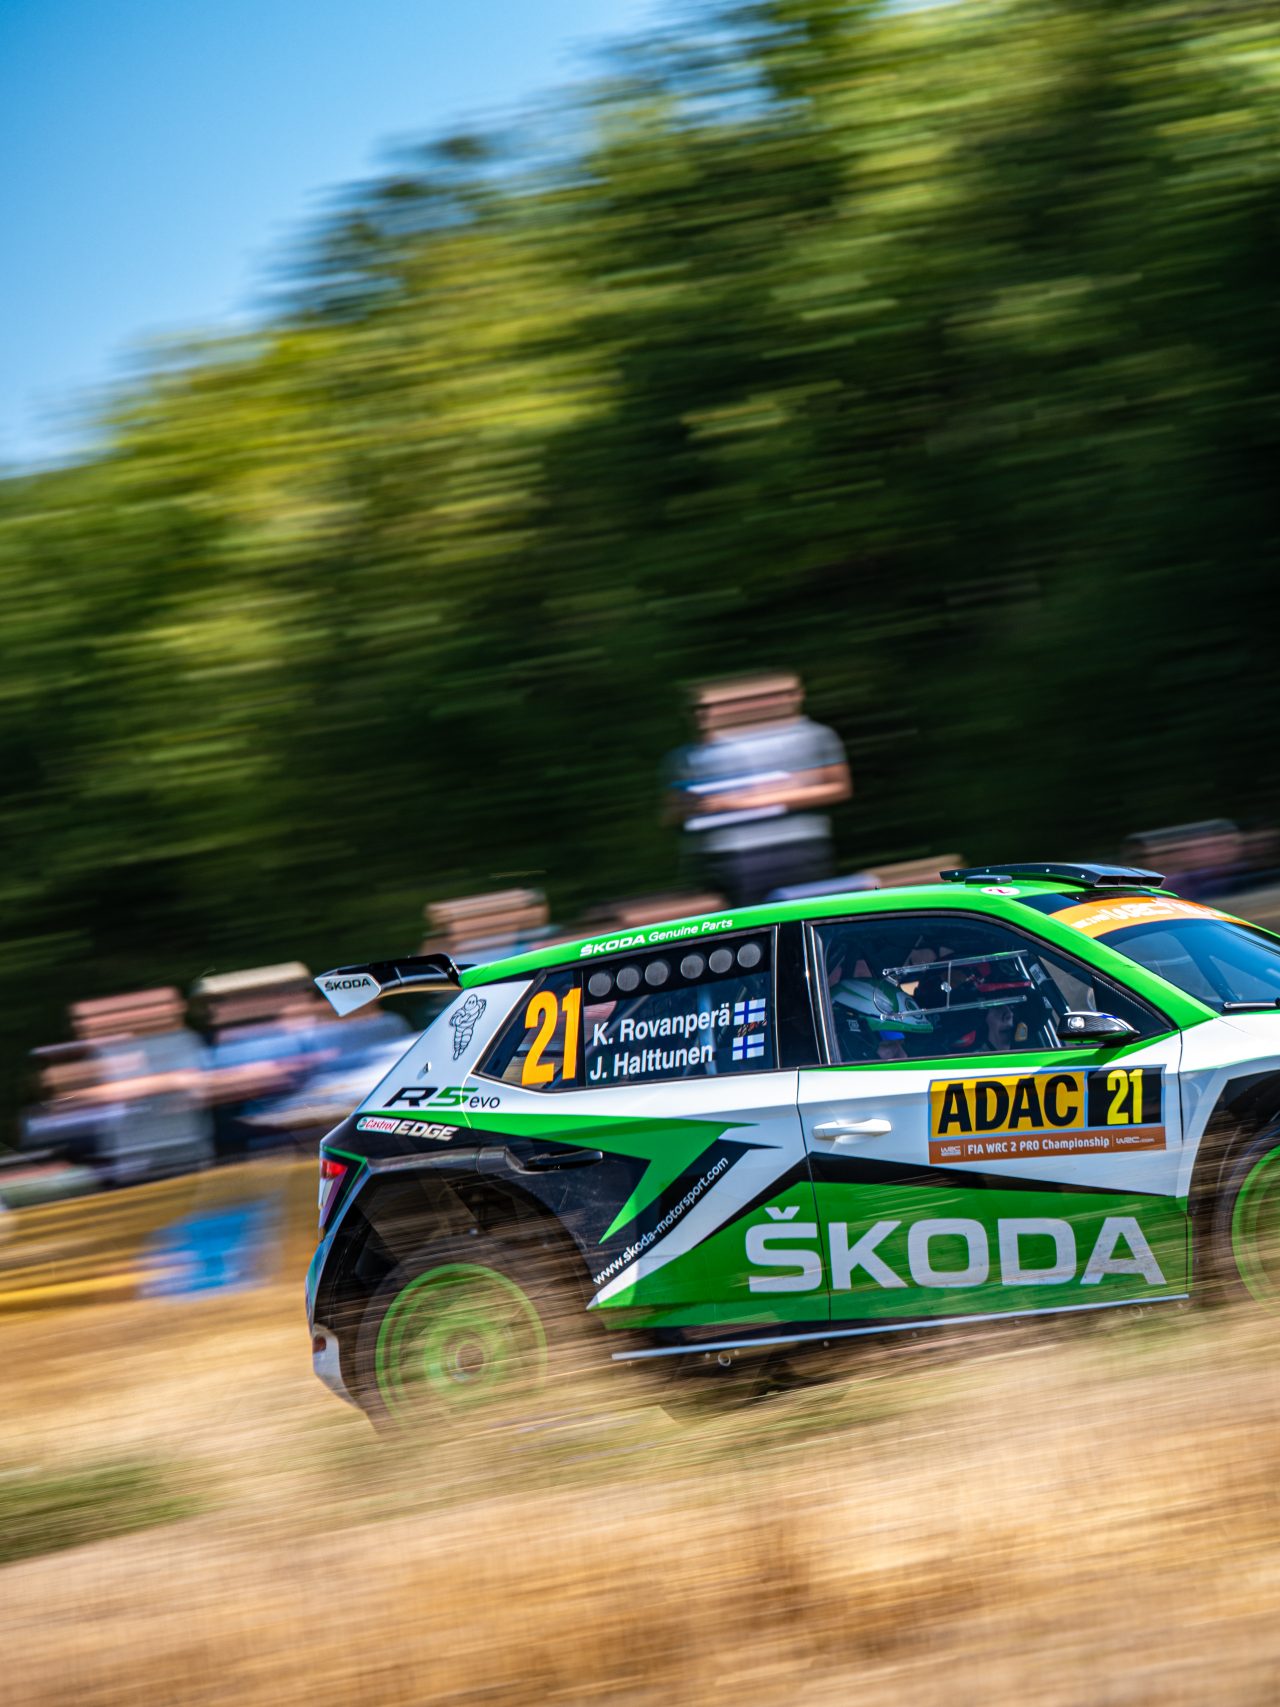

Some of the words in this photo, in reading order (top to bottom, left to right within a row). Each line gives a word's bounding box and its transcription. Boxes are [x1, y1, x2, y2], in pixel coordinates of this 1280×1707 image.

[580, 934, 646, 957] ŠKODA
[648, 924, 699, 942] Genuine
[701, 919, 733, 932] Parts
[325, 978, 370, 991] ŠKODA
[522, 987, 582, 1086] 21
[592, 1023, 614, 1047] K.
[619, 1002, 731, 1043] Rovanperä
[589, 1056, 608, 1081] J.
[613, 1044, 714, 1077] Halttunen
[937, 1074, 1079, 1134] ADAC
[1106, 1068, 1144, 1126] 21
[365, 1118, 396, 1132] Castrol
[394, 1120, 460, 1141] EDGE
[967, 1143, 984, 1155] FIA
[986, 1142, 1008, 1154] WRC
[1010, 1141, 1017, 1152] 2
[1019, 1139, 1039, 1151] PRO
[1042, 1136, 1110, 1150] Championship
[593, 1157, 729, 1285] www.skoda-motorsport.com
[745, 1206, 1168, 1293] ŠKODA
